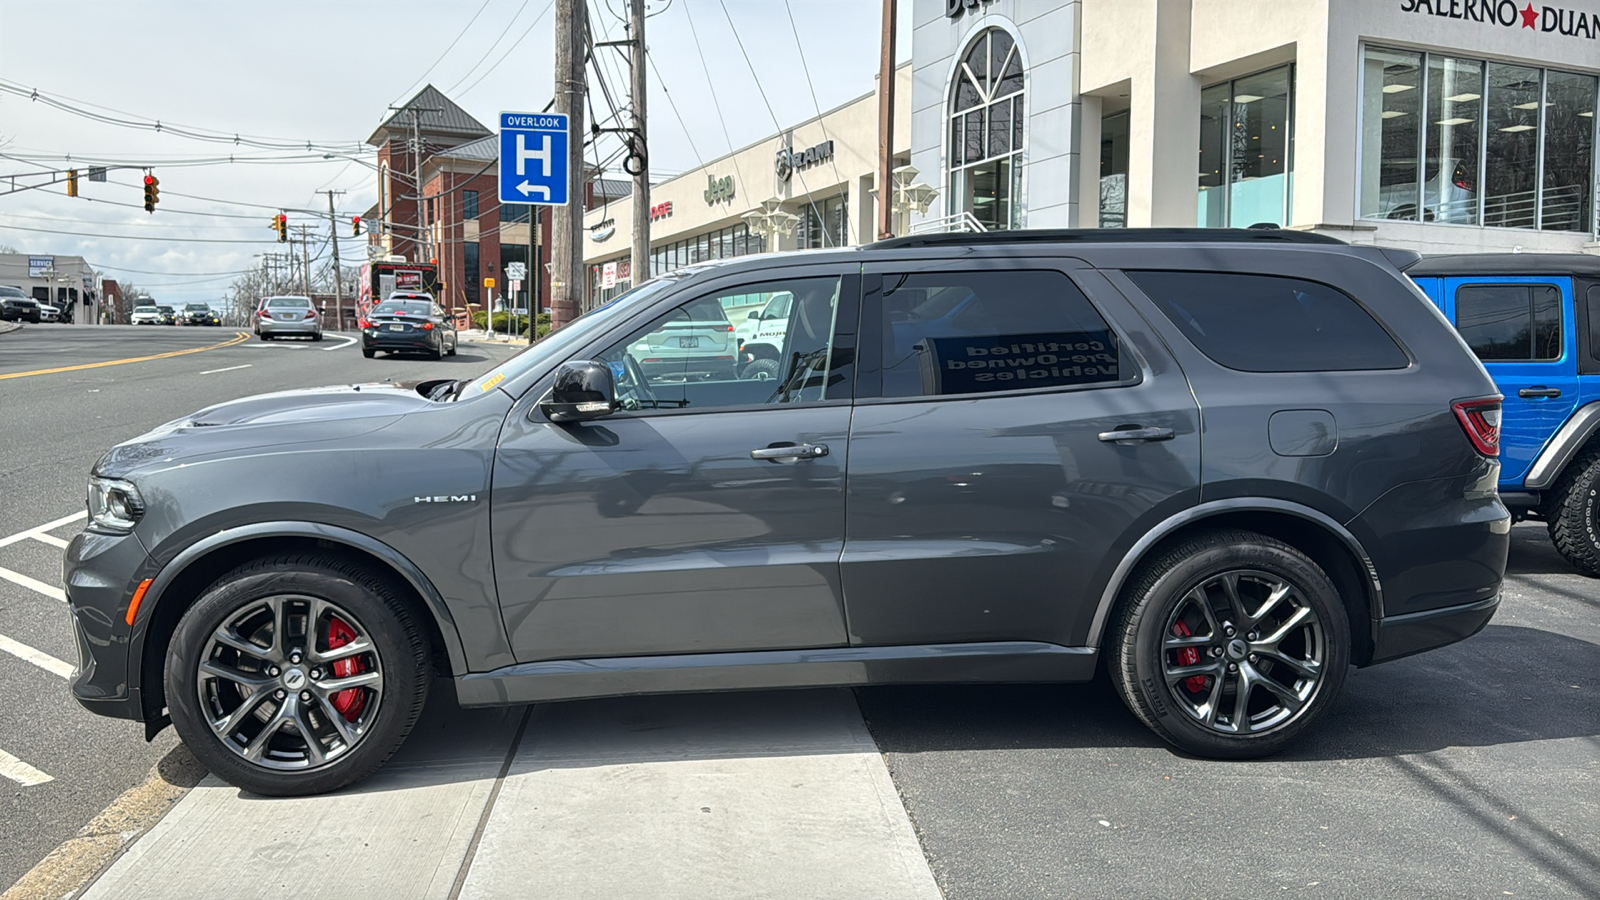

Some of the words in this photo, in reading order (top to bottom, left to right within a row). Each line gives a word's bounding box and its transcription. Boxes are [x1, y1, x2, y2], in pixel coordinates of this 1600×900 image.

[1541, 6, 1600, 40] DUAN
[507, 116, 559, 127] OVERLOOK
[516, 134, 551, 177] H
[793, 140, 833, 169] RAM
[704, 174, 735, 204] Jeep
[650, 201, 672, 218] DGE
